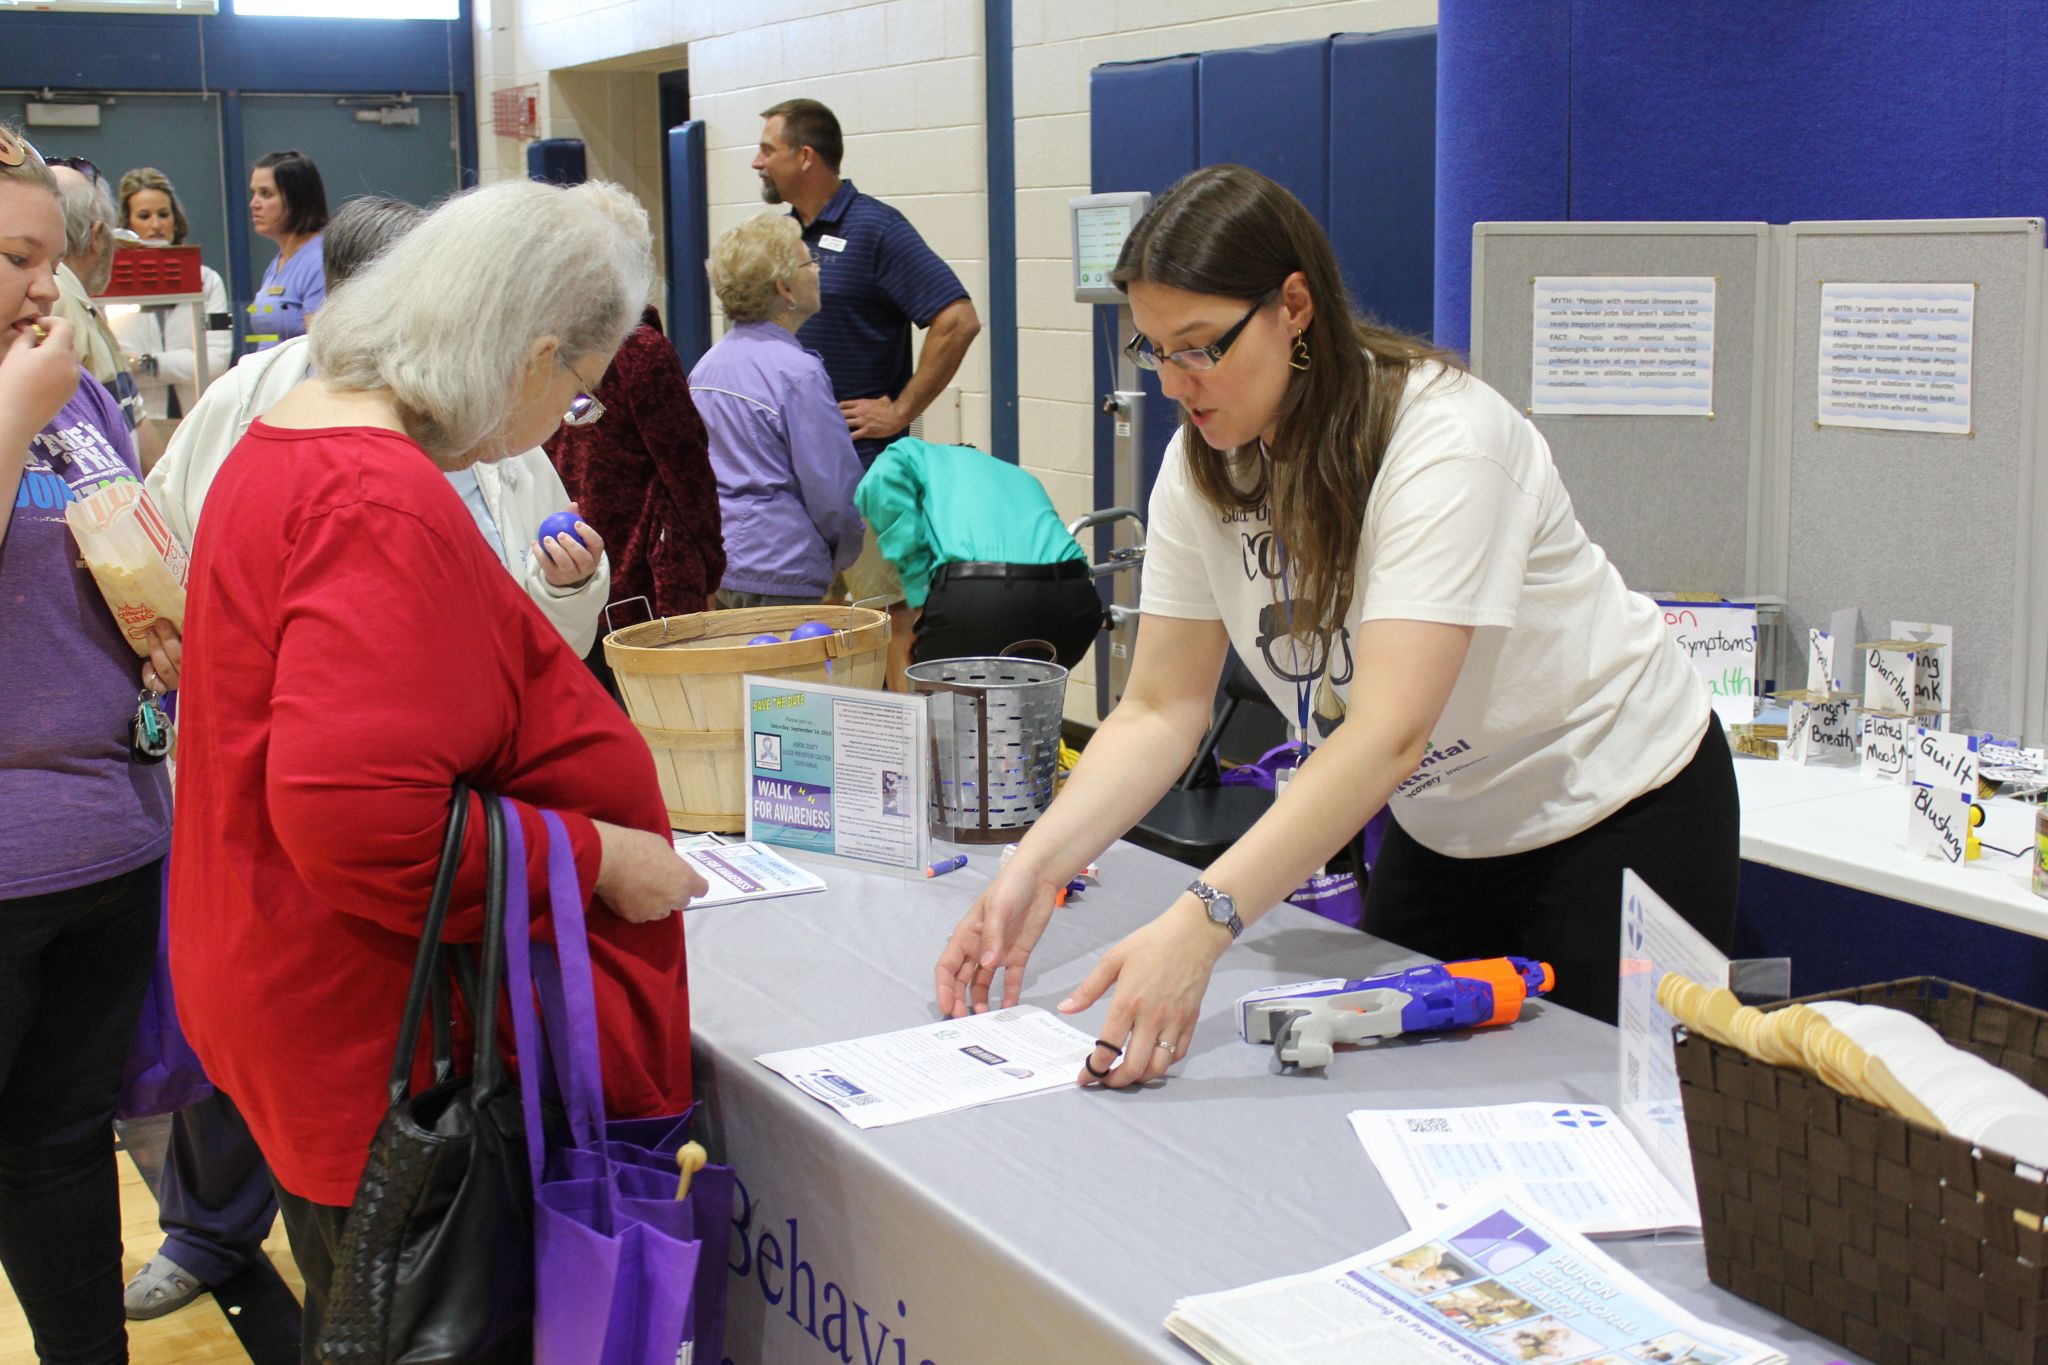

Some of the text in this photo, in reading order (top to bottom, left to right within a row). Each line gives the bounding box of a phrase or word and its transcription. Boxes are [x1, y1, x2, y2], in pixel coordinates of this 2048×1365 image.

[1639, 370, 1677, 378] experience
[1676, 630, 1754, 658] Symptoms
[1869, 649, 1911, 712] Diarrhea
[752, 692, 806, 712] SAVE THE DATE
[1823, 714, 1838, 727] of
[1864, 719, 1902, 741] Elated
[1811, 724, 1854, 752] Breath
[1866, 743, 1897, 765] Mood
[1920, 736, 1974, 786] Guilt
[757, 780, 792, 800] WALK
[754, 799, 772, 819] FOR
[774, 803, 830, 829] AWARENESS
[1914, 787, 1962, 863] Blushing
[1549, 1253, 1620, 1301] HURON
[1335, 1278, 1394, 1315] Continuing
[1510, 1273, 1583, 1319] HEALTH
[1529, 1264, 1641, 1337] BEHAVIORAL
